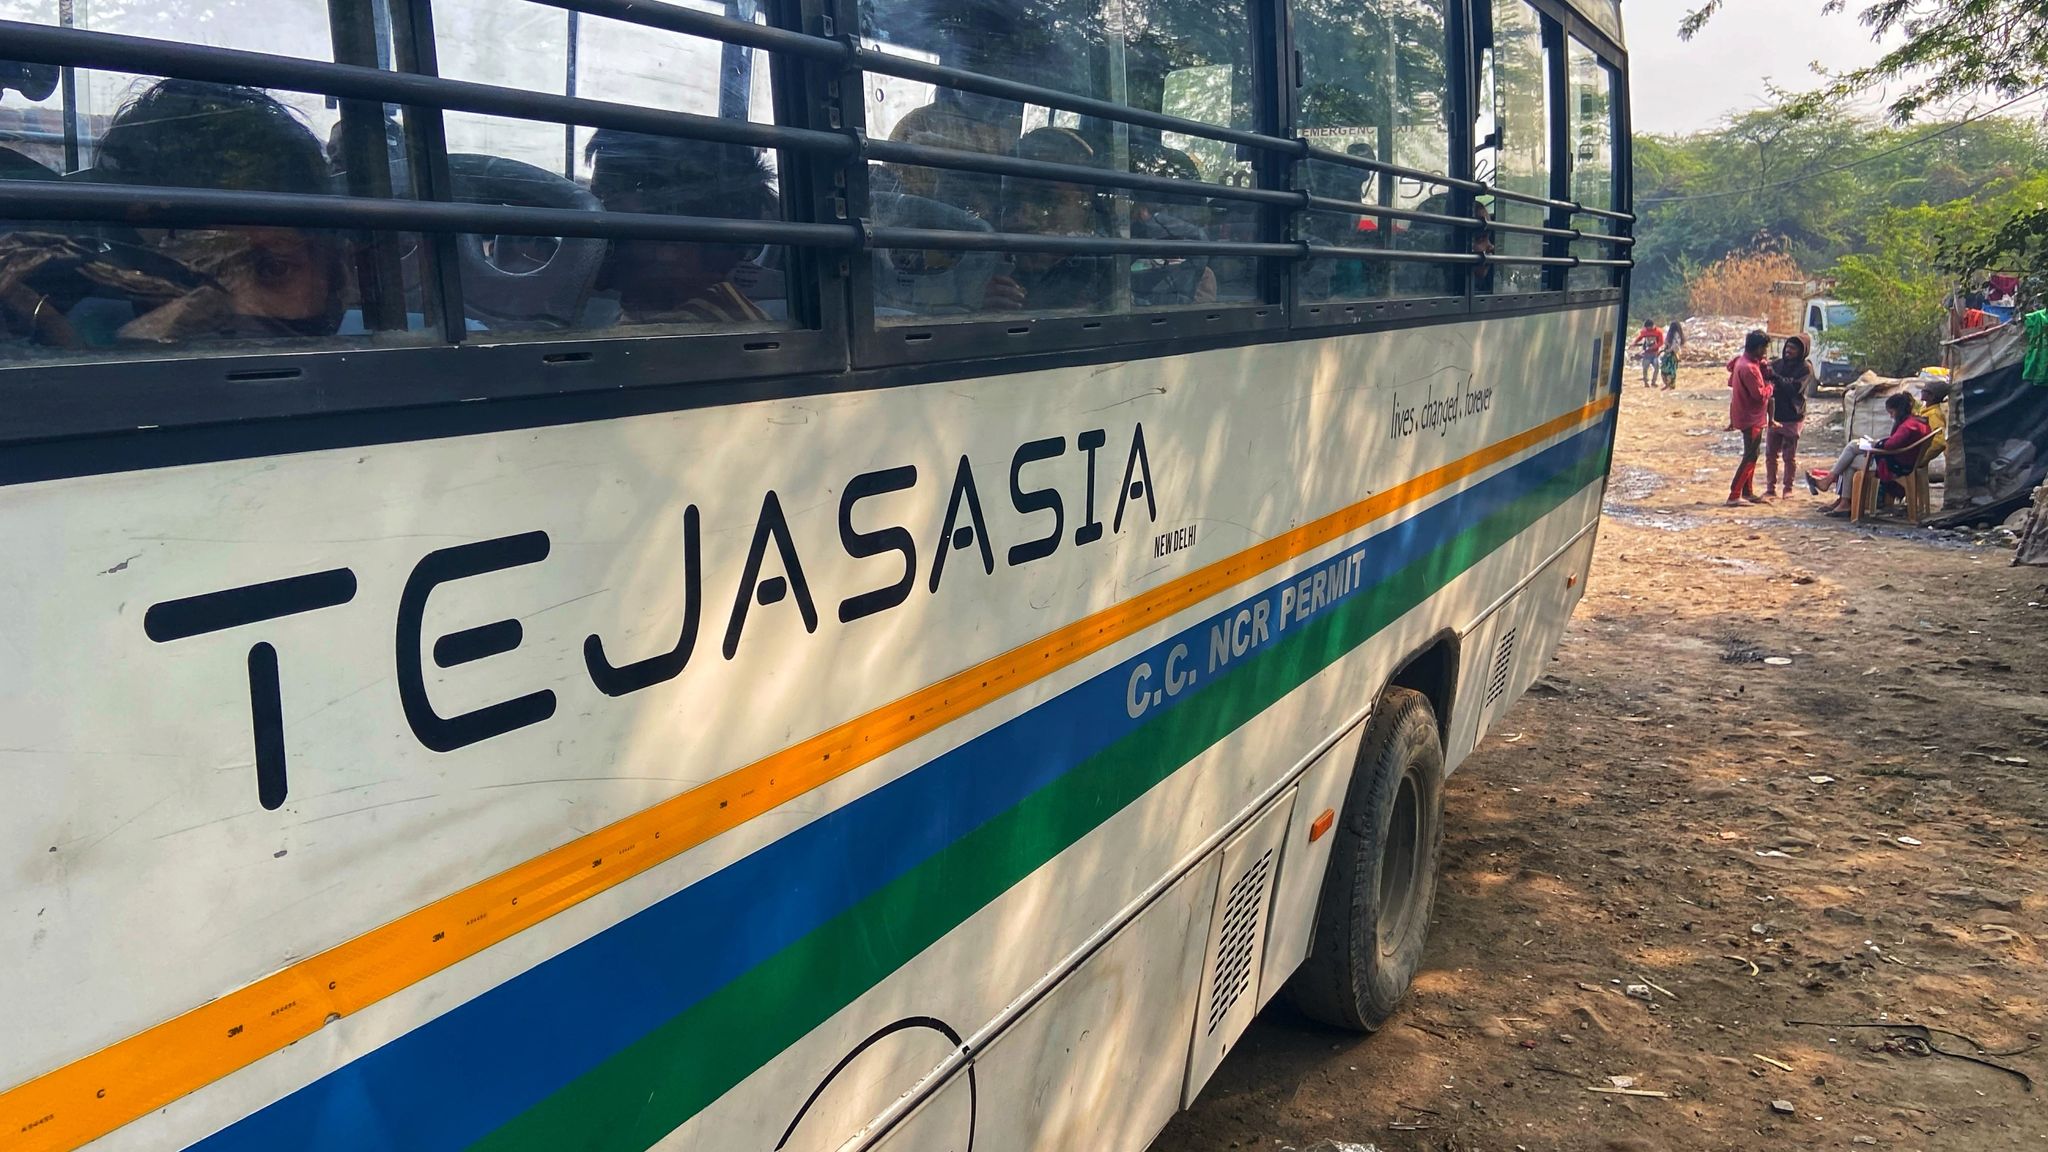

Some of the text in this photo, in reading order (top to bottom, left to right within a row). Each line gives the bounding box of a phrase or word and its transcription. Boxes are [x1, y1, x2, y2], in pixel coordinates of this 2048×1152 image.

[1464, 373, 1493, 417] forever
[1153, 524, 1197, 559] NEW DELHI
[1126, 549, 1366, 719] C.C. NCR PERMIT
[432, 931, 445, 942] 3M
[227, 1024, 244, 1038] 3M
[328, 981, 336, 990] C
[96, 1089, 105, 1099] C
